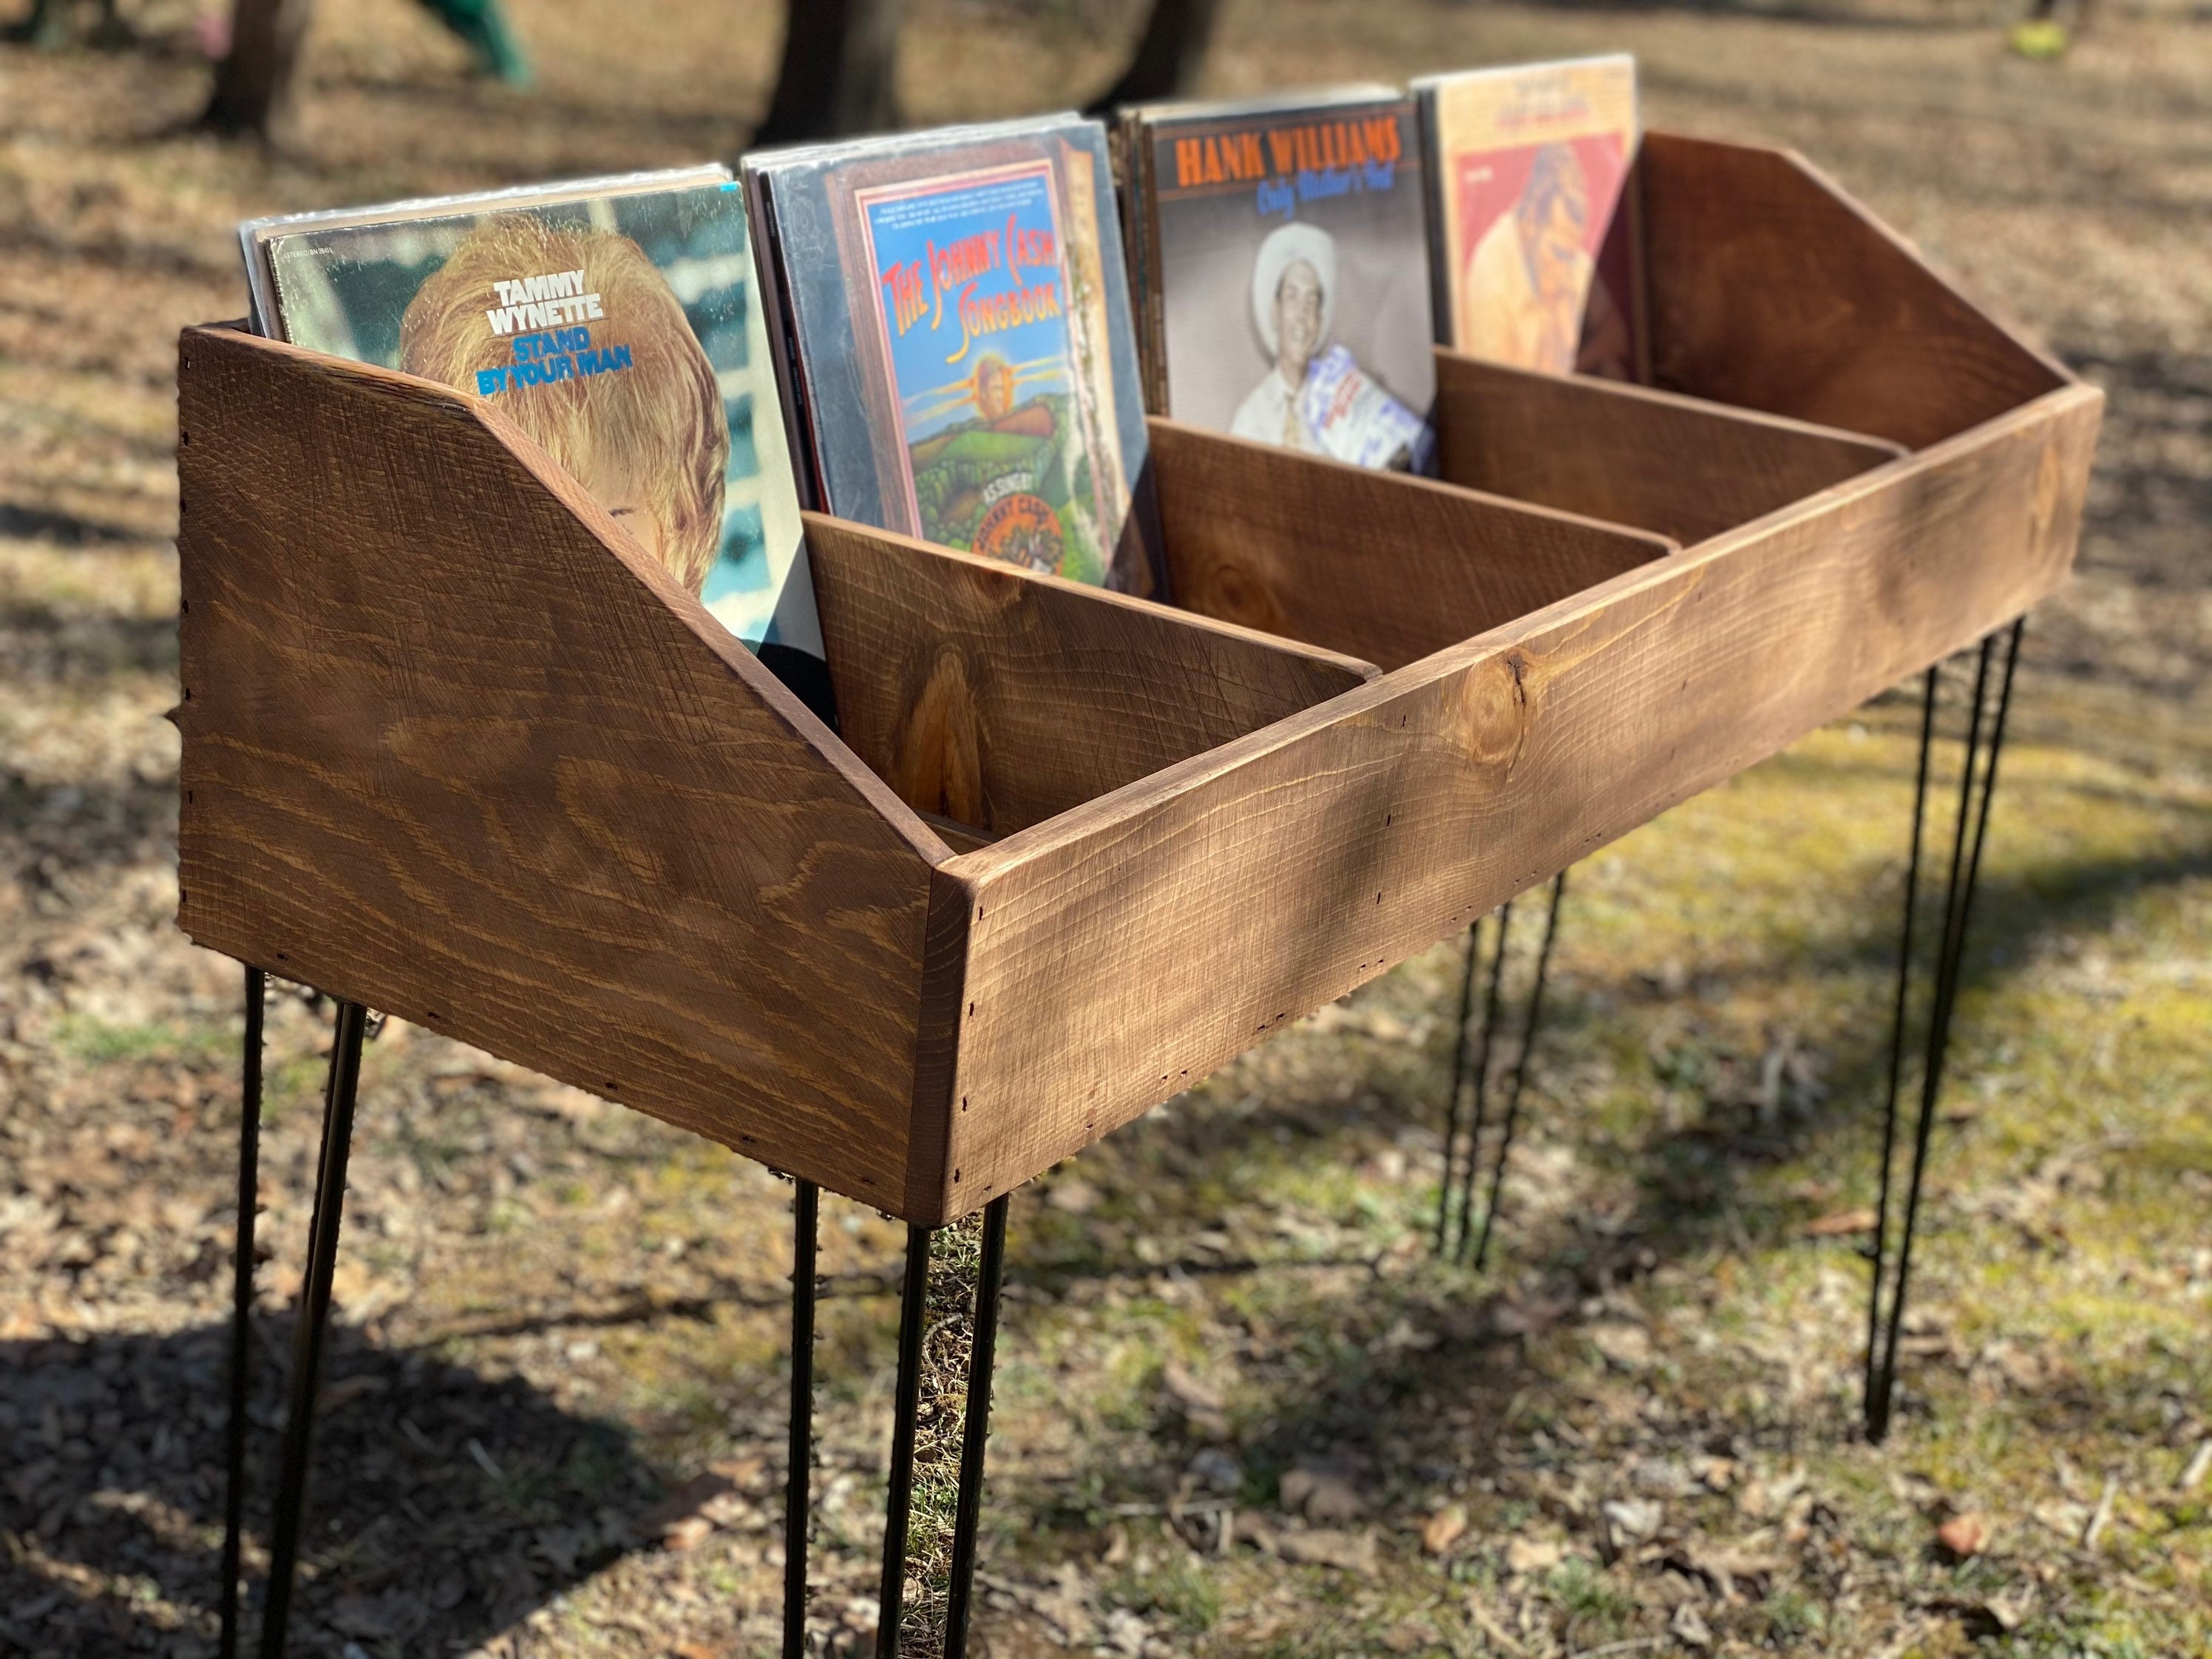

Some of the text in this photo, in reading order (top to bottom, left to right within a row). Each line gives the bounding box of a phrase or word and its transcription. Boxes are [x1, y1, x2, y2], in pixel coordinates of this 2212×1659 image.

[1175, 115, 1401, 188] HANK WILLIAMS
[285, 250, 308, 259] STEREO
[882, 213, 1058, 337] THE JOHNNY CASH
[493, 269, 584, 307] TAMMY
[486, 293, 603, 336] WYNETTE
[946, 281, 1062, 364] SONGBOOK
[512, 325, 590, 362] STAND
[475, 343, 633, 396] BY YOUR MAN
